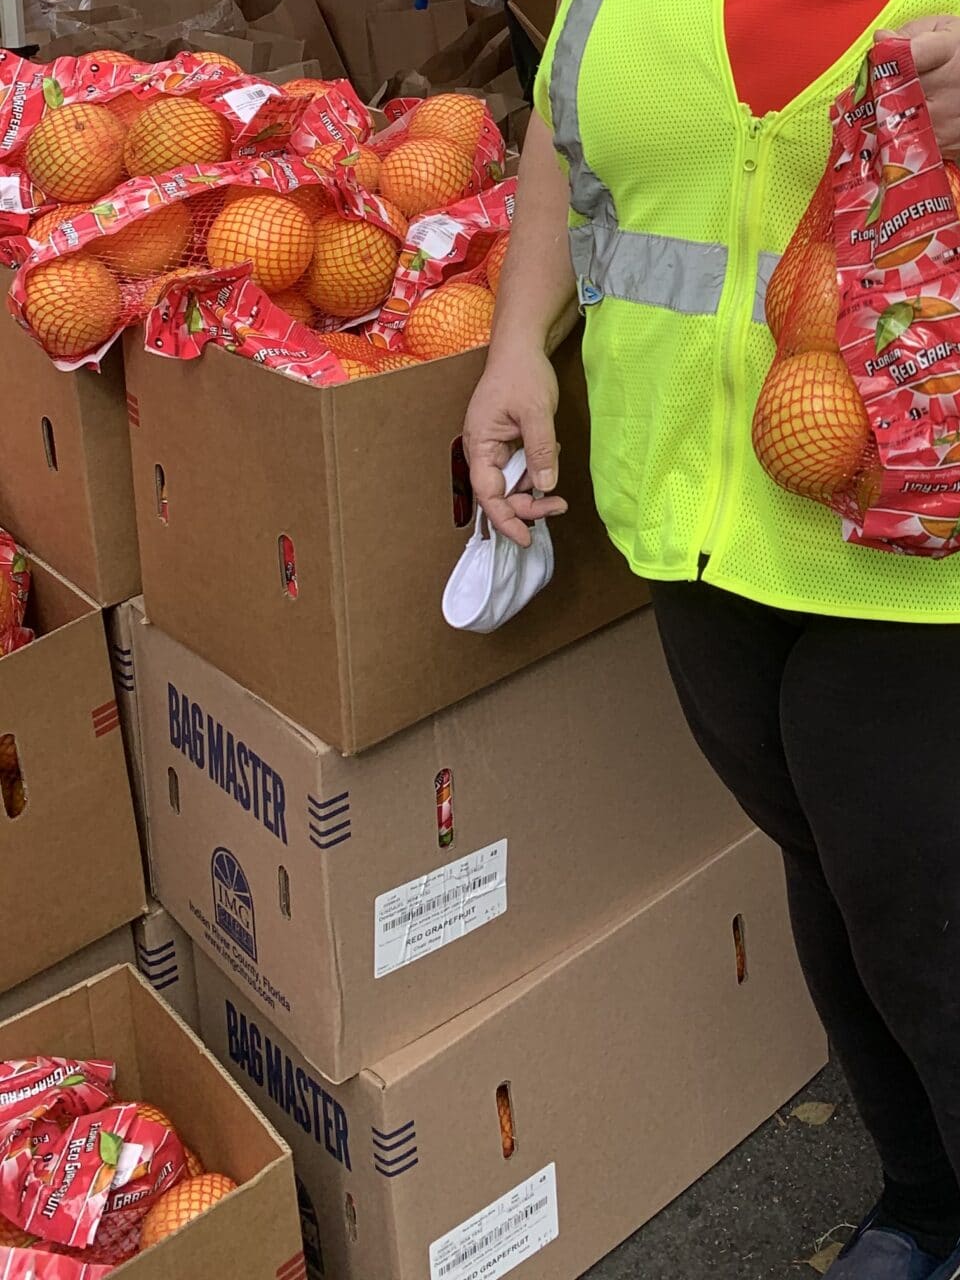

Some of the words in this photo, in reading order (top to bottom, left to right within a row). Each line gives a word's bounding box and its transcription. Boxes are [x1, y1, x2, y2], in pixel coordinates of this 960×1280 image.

[167, 681, 206, 770] BAG
[206, 713, 289, 847] MASTER
[218, 883, 251, 930] IMG
[405, 933, 424, 947] RED
[424, 906, 476, 938] GRAPEFRUIT
[225, 999, 264, 1088] BAG
[263, 1035, 352, 1173] MASTER
